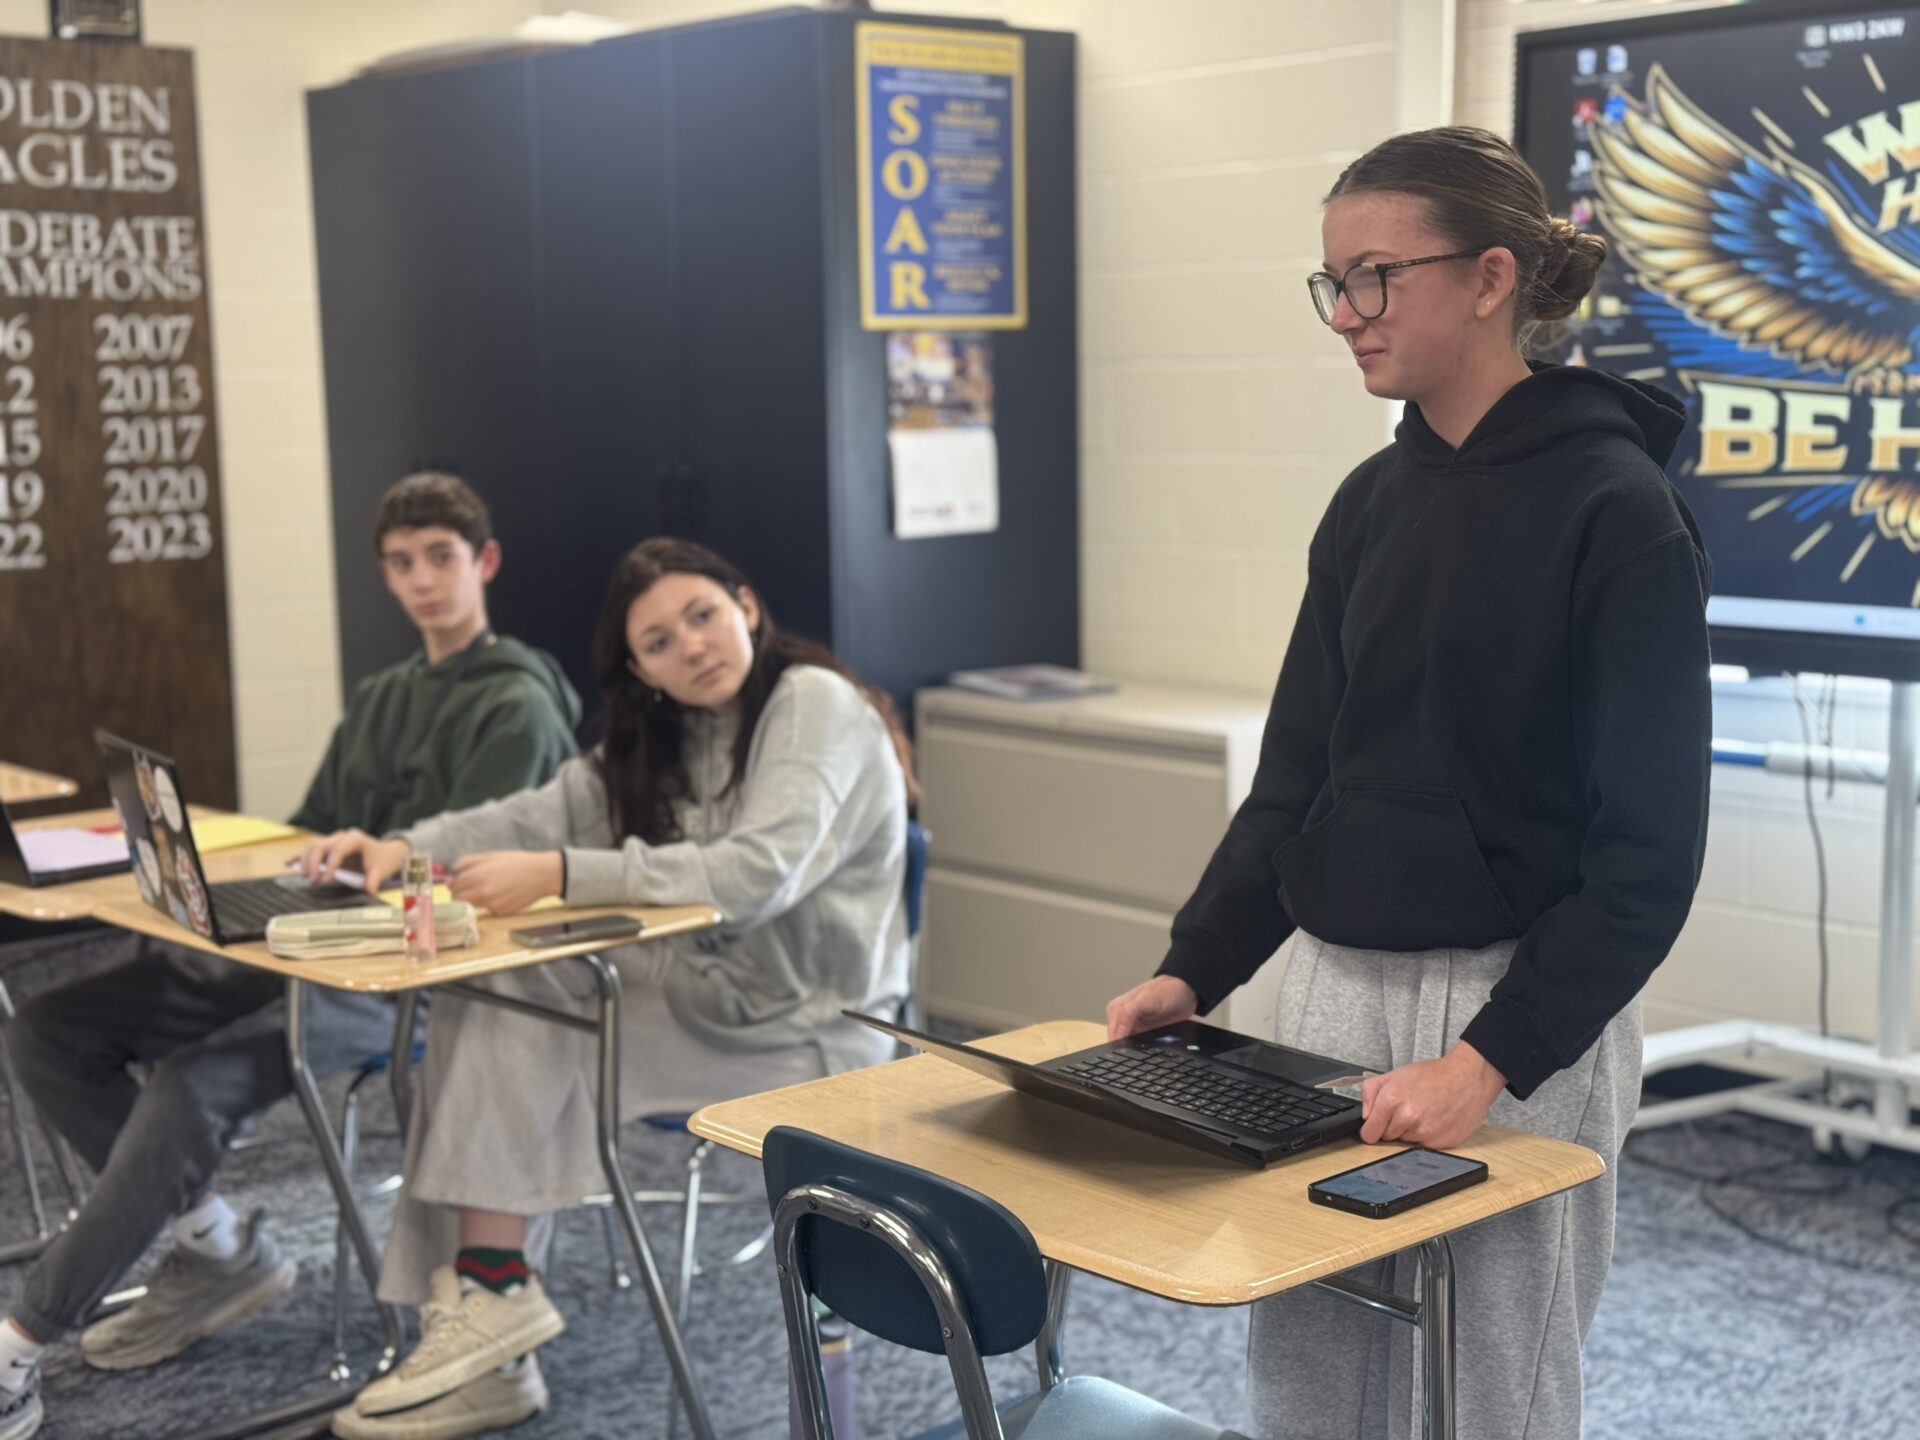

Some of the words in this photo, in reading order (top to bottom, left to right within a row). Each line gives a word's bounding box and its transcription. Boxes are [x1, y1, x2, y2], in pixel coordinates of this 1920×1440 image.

[881, 94, 931, 310] SOAR
[0, 209, 195, 260] DEBATE
[0, 313, 33, 361] 6
[94, 313, 194, 361] 2007
[0, 365, 37, 413] 2
[98, 364, 202, 412] 2013
[102, 415, 206, 464] 2017
[104, 465, 208, 515] 2020
[107, 512, 213, 563] 2023
